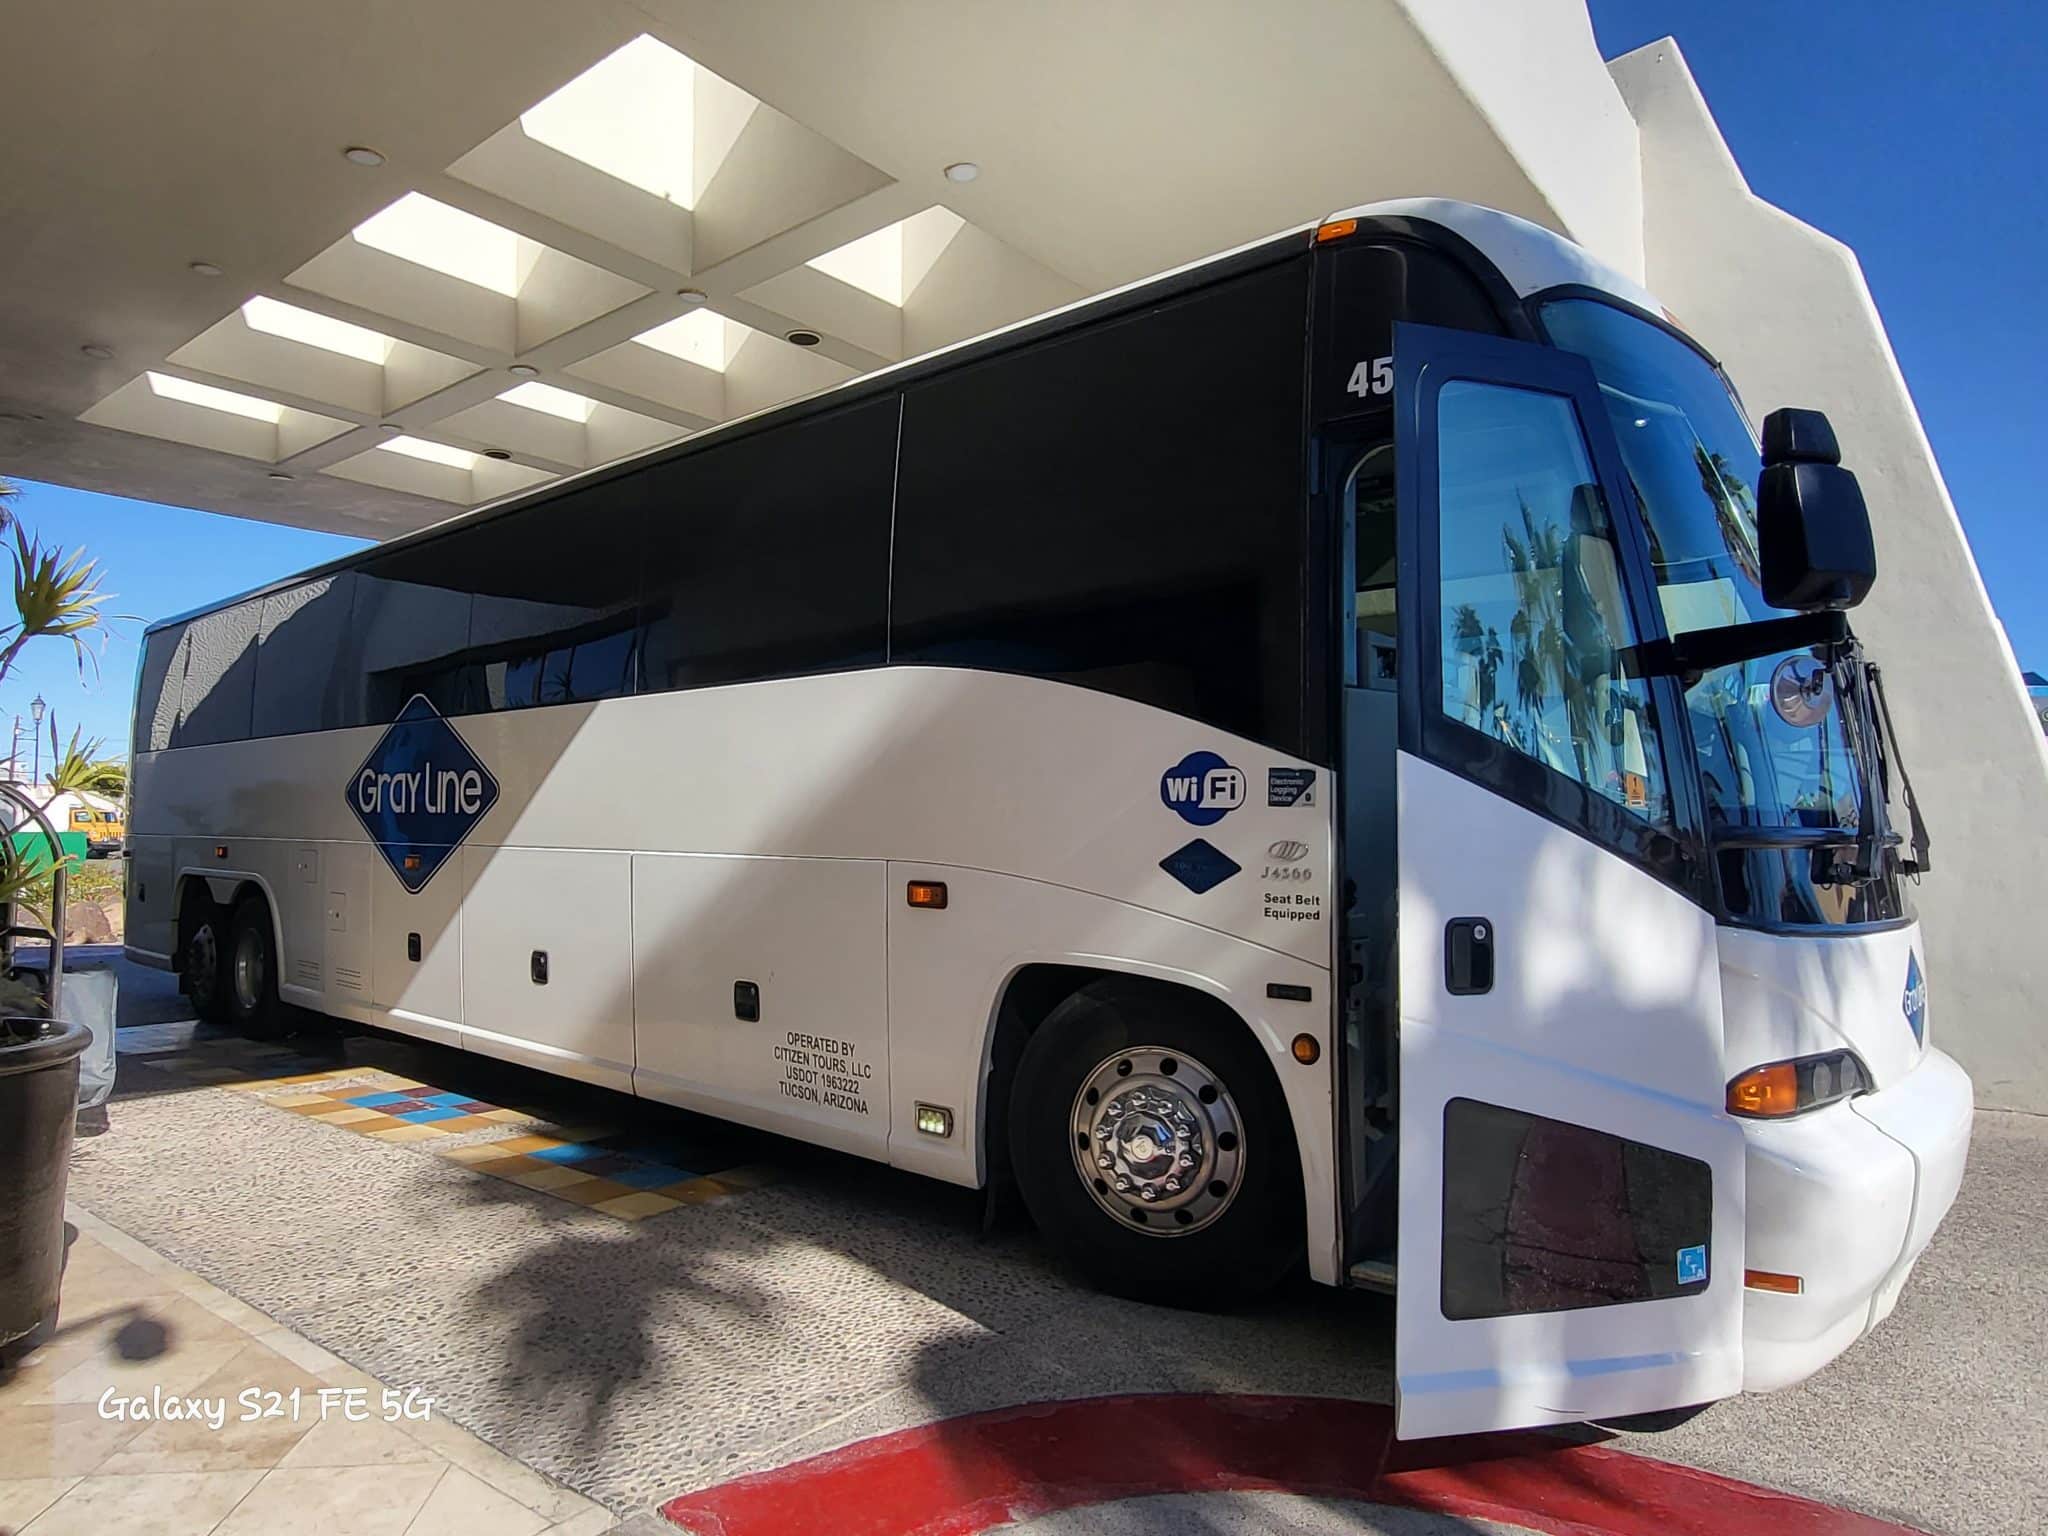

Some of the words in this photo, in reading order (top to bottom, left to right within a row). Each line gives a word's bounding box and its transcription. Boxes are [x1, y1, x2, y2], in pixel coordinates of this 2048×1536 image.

[1264, 893, 1292, 904] Seat
[1296, 894, 1320, 906] Belt
[1264, 907, 1320, 922] Equipped
[786, 1031, 839, 1054] OPERATED
[841, 1042, 855, 1057] BY
[774, 1046, 809, 1066] CITIZEN
[812, 1054, 849, 1076] TOURS,
[851, 1062, 872, 1079] LLC
[785, 1066, 818, 1085] USDOT
[821, 1073, 860, 1094] 1963222
[778, 1081, 821, 1106] TUCSON,
[823, 1091, 869, 1115] ARIZONA
